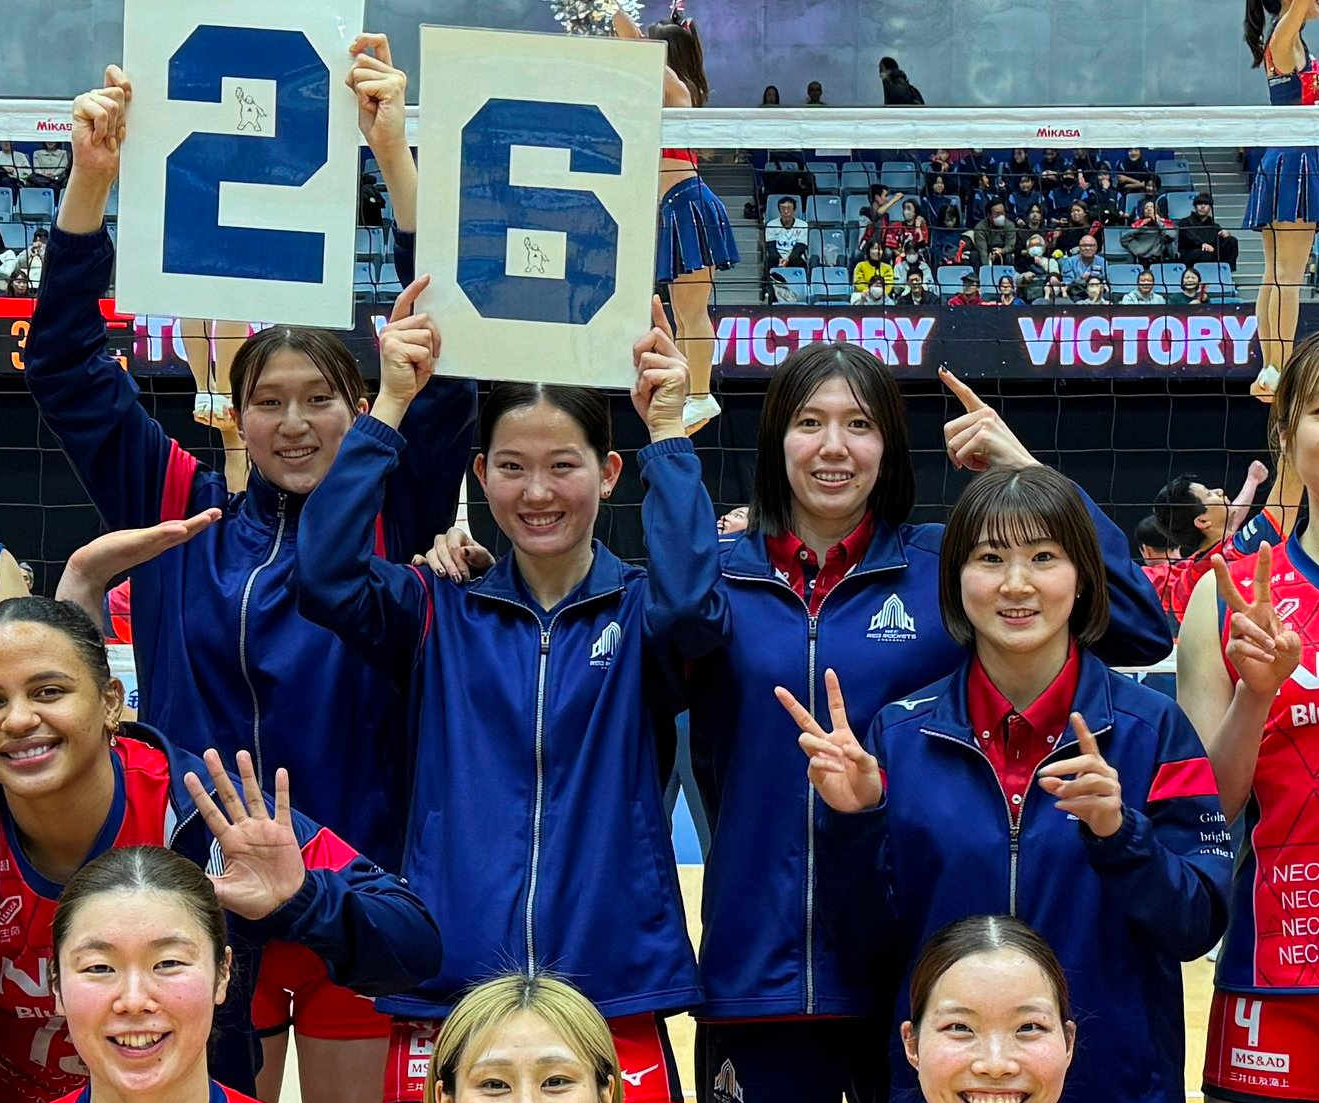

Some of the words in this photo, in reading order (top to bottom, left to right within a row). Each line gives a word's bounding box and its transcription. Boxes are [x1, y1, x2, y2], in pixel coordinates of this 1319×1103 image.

[162, 24, 330, 284] 2
[457, 98, 623, 325] 6
[1019, 317, 1259, 365] VICTORY
[1234, 997, 1262, 1047] 4
[1235, 1052, 1285, 1068] MS&AD
